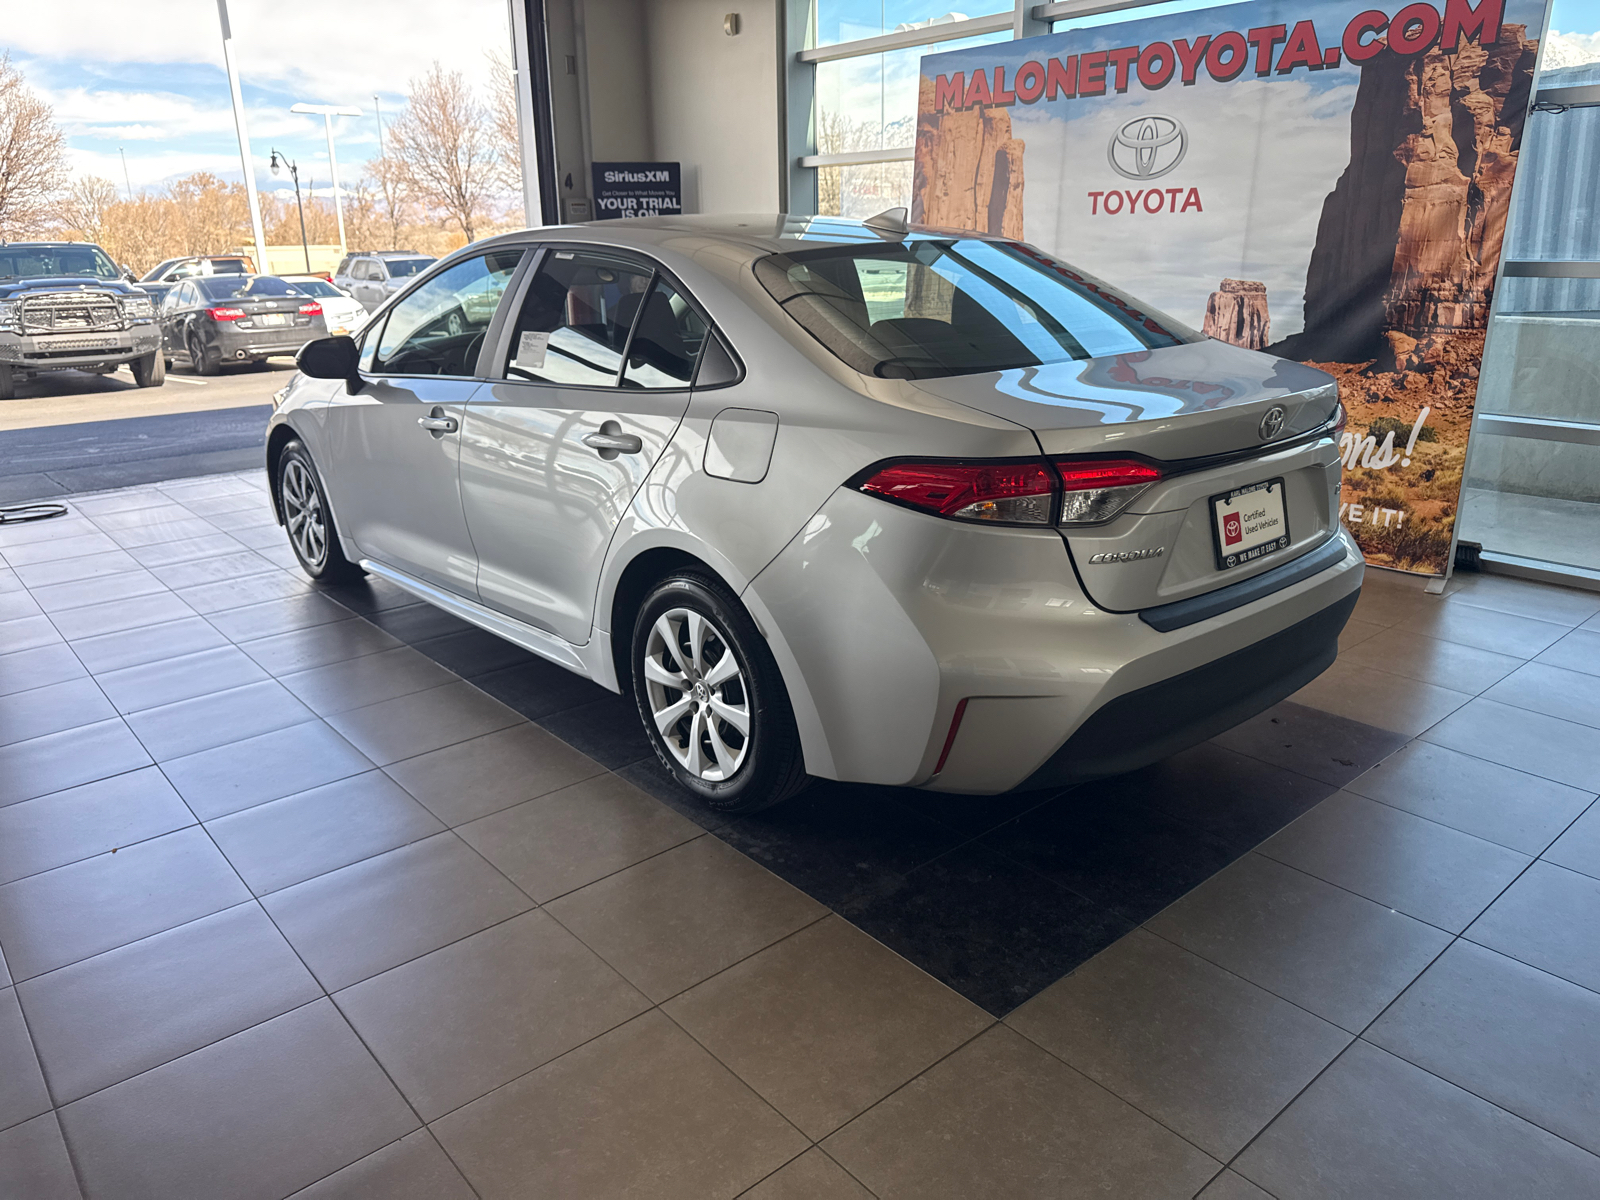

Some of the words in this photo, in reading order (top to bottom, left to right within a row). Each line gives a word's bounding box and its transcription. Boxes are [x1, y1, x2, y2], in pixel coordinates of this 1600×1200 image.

[935, 0, 1505, 113] MALONETOYOTA.COM
[604, 171, 670, 183] SiriusXM
[598, 198, 637, 210] YOUR
[640, 197, 681, 209] TRIAL
[1087, 187, 1203, 215] TOYOTA
[1243, 508, 1266, 522] Certified
[1371, 507, 1404, 529] IT!
[1245, 523, 1258, 535] Used
[1258, 518, 1279, 530] Vehicles
[1088, 546, 1164, 564] COROLLA
[1239, 553, 1247, 562] WE
[1247, 547, 1260, 558] MAKE
[1260, 544, 1266, 554] IT
[1266, 541, 1277, 553] EASY
